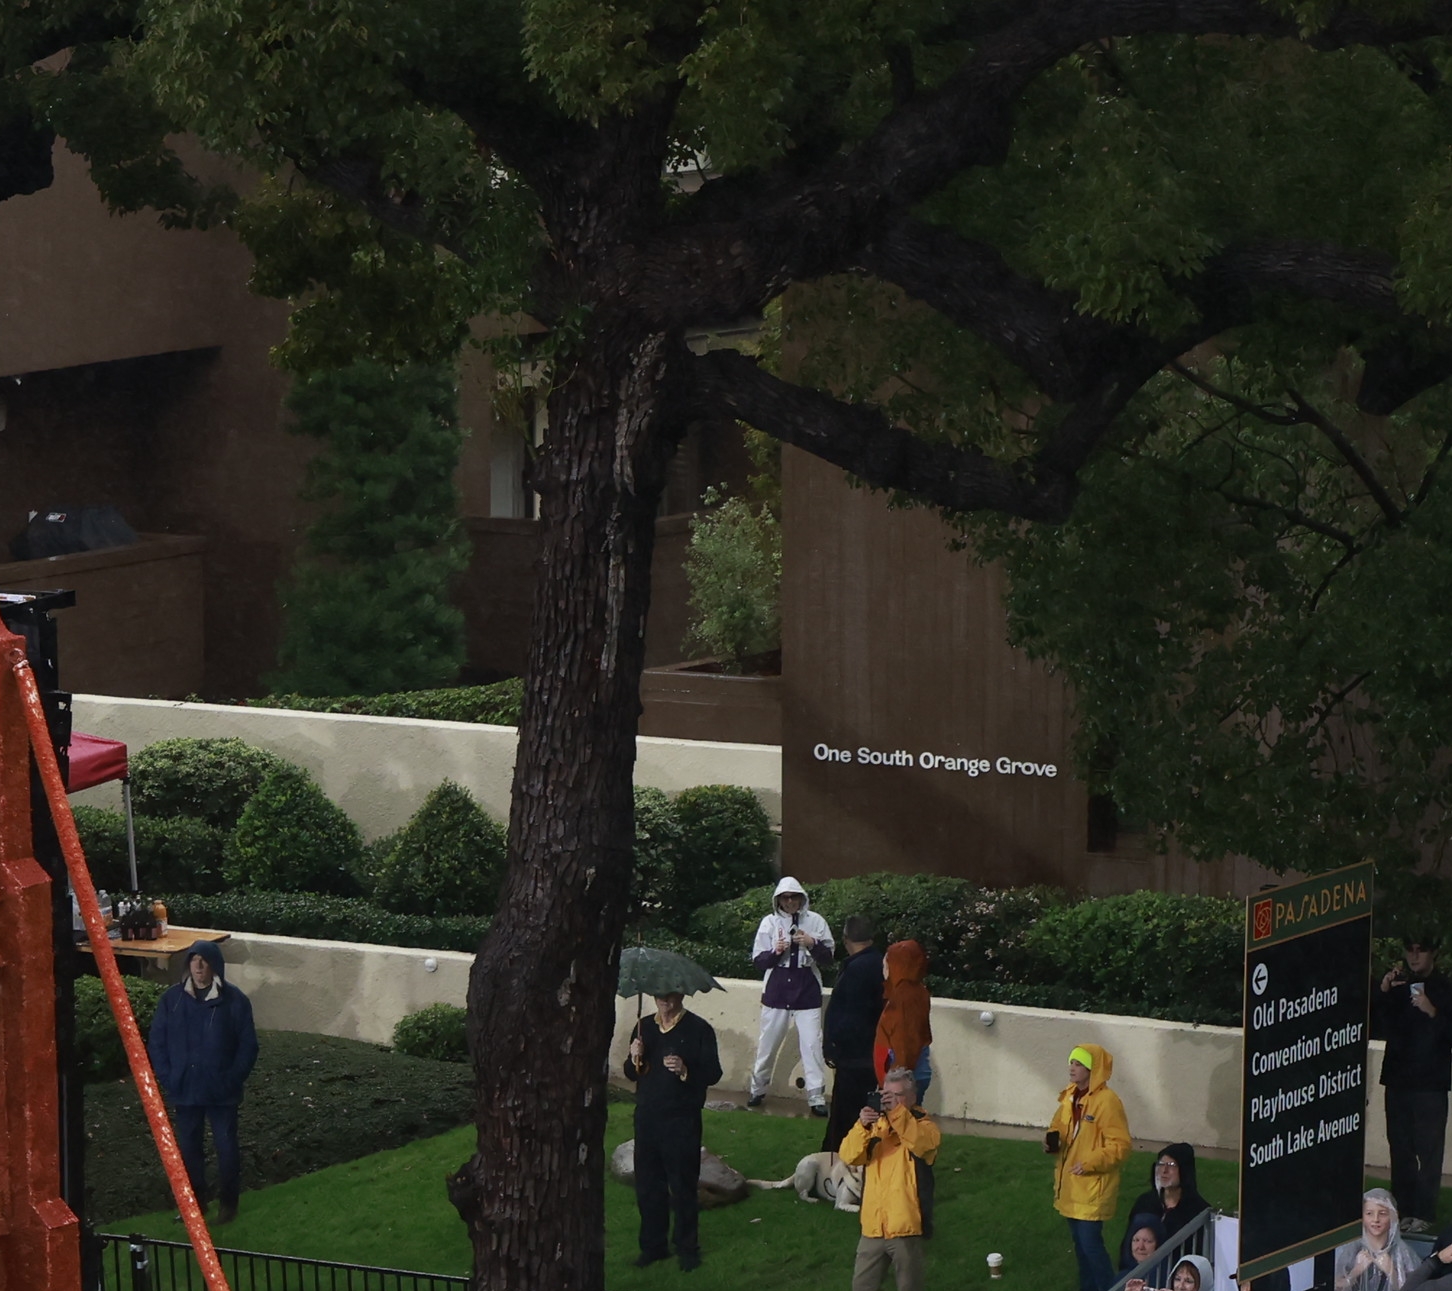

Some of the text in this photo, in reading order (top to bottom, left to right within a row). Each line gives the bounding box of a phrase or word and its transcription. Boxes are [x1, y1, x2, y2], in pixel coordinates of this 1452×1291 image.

[813, 743, 1057, 778] One South Orange Grove
[1276, 880, 1366, 929] PASADENA
[1253, 986, 1338, 1031] Old Pasadena
[1252, 1022, 1363, 1076] Convention Center
[1251, 1064, 1361, 1123] Playhouse District
[1250, 1112, 1360, 1168] South Lake Avenue
